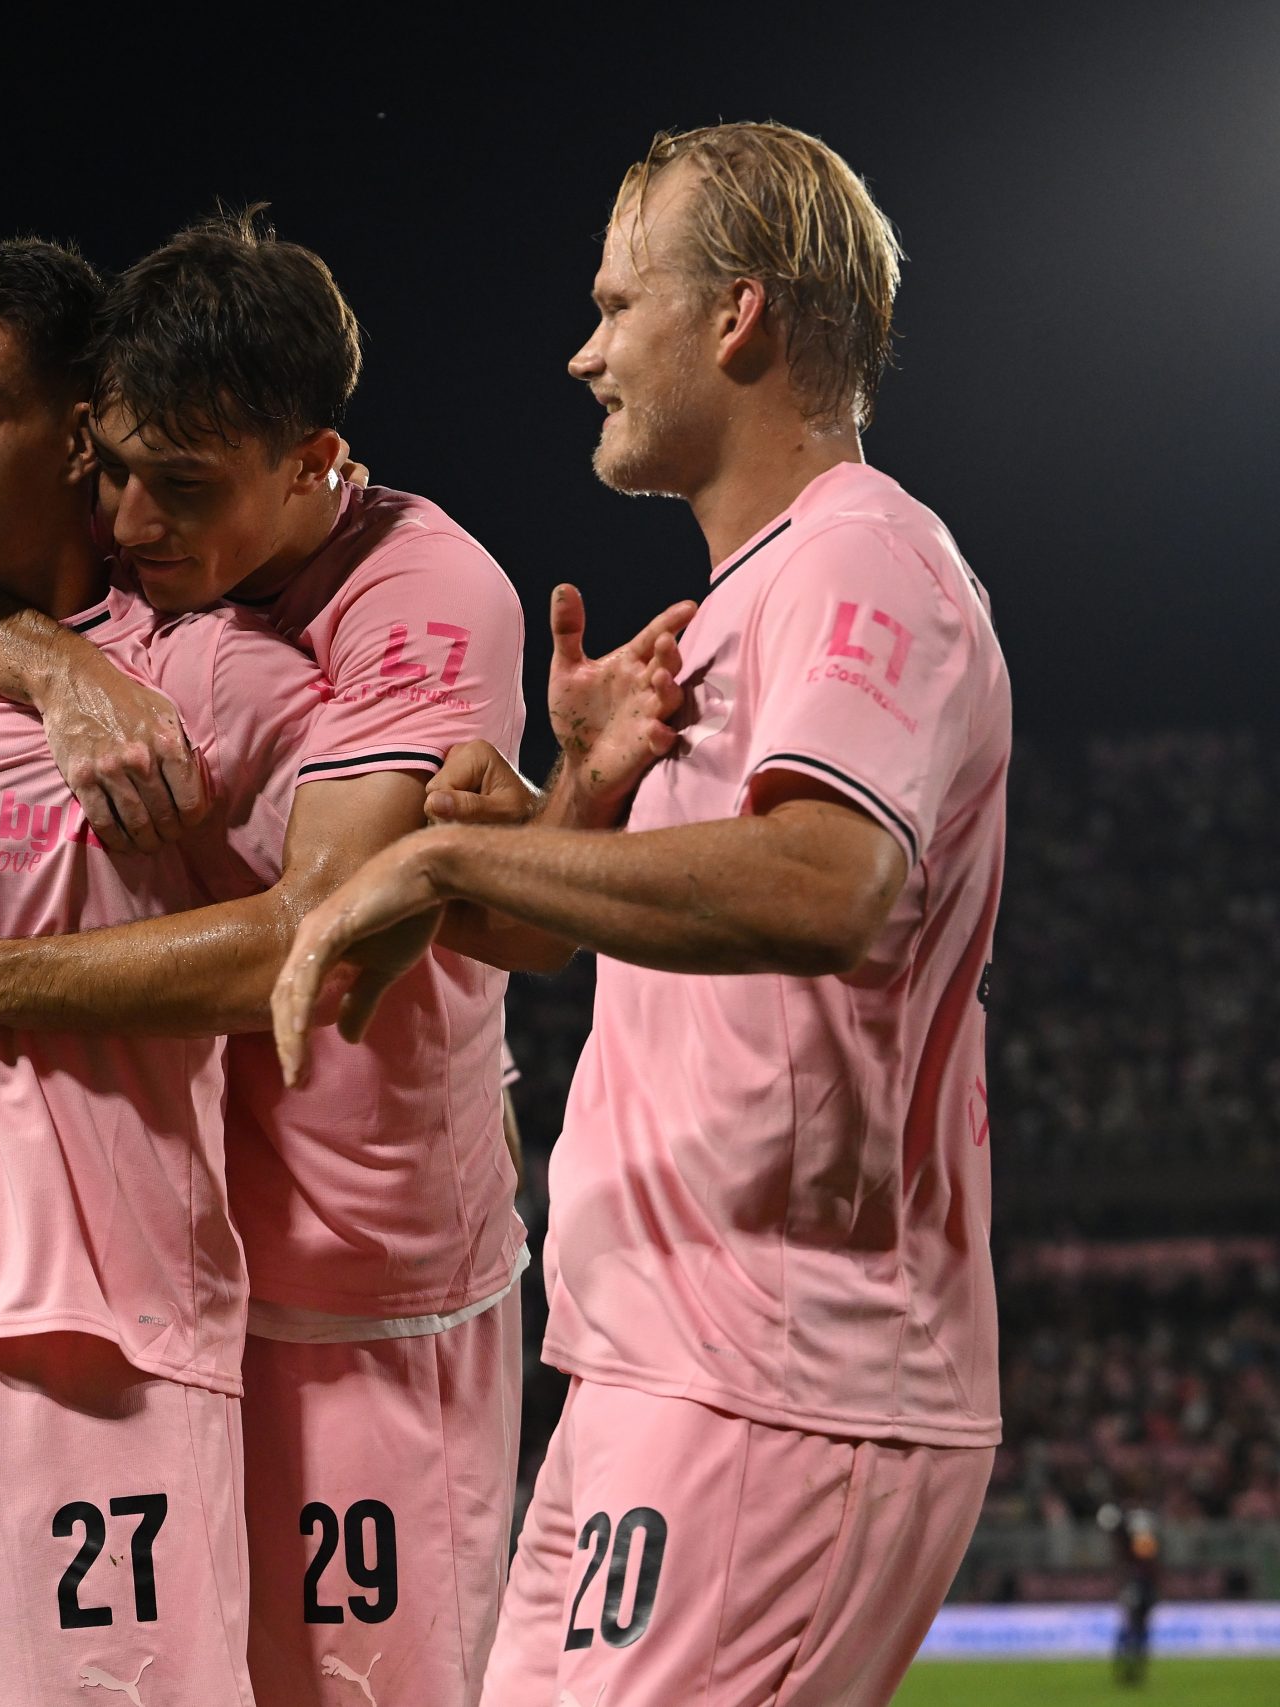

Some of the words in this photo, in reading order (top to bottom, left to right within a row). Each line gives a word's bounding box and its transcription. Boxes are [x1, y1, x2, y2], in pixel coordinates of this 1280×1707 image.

[0, 790, 63, 852] by
[52, 1493, 168, 1630] 27
[299, 1498, 399, 1624] 29
[563, 1506, 668, 1652] 20
